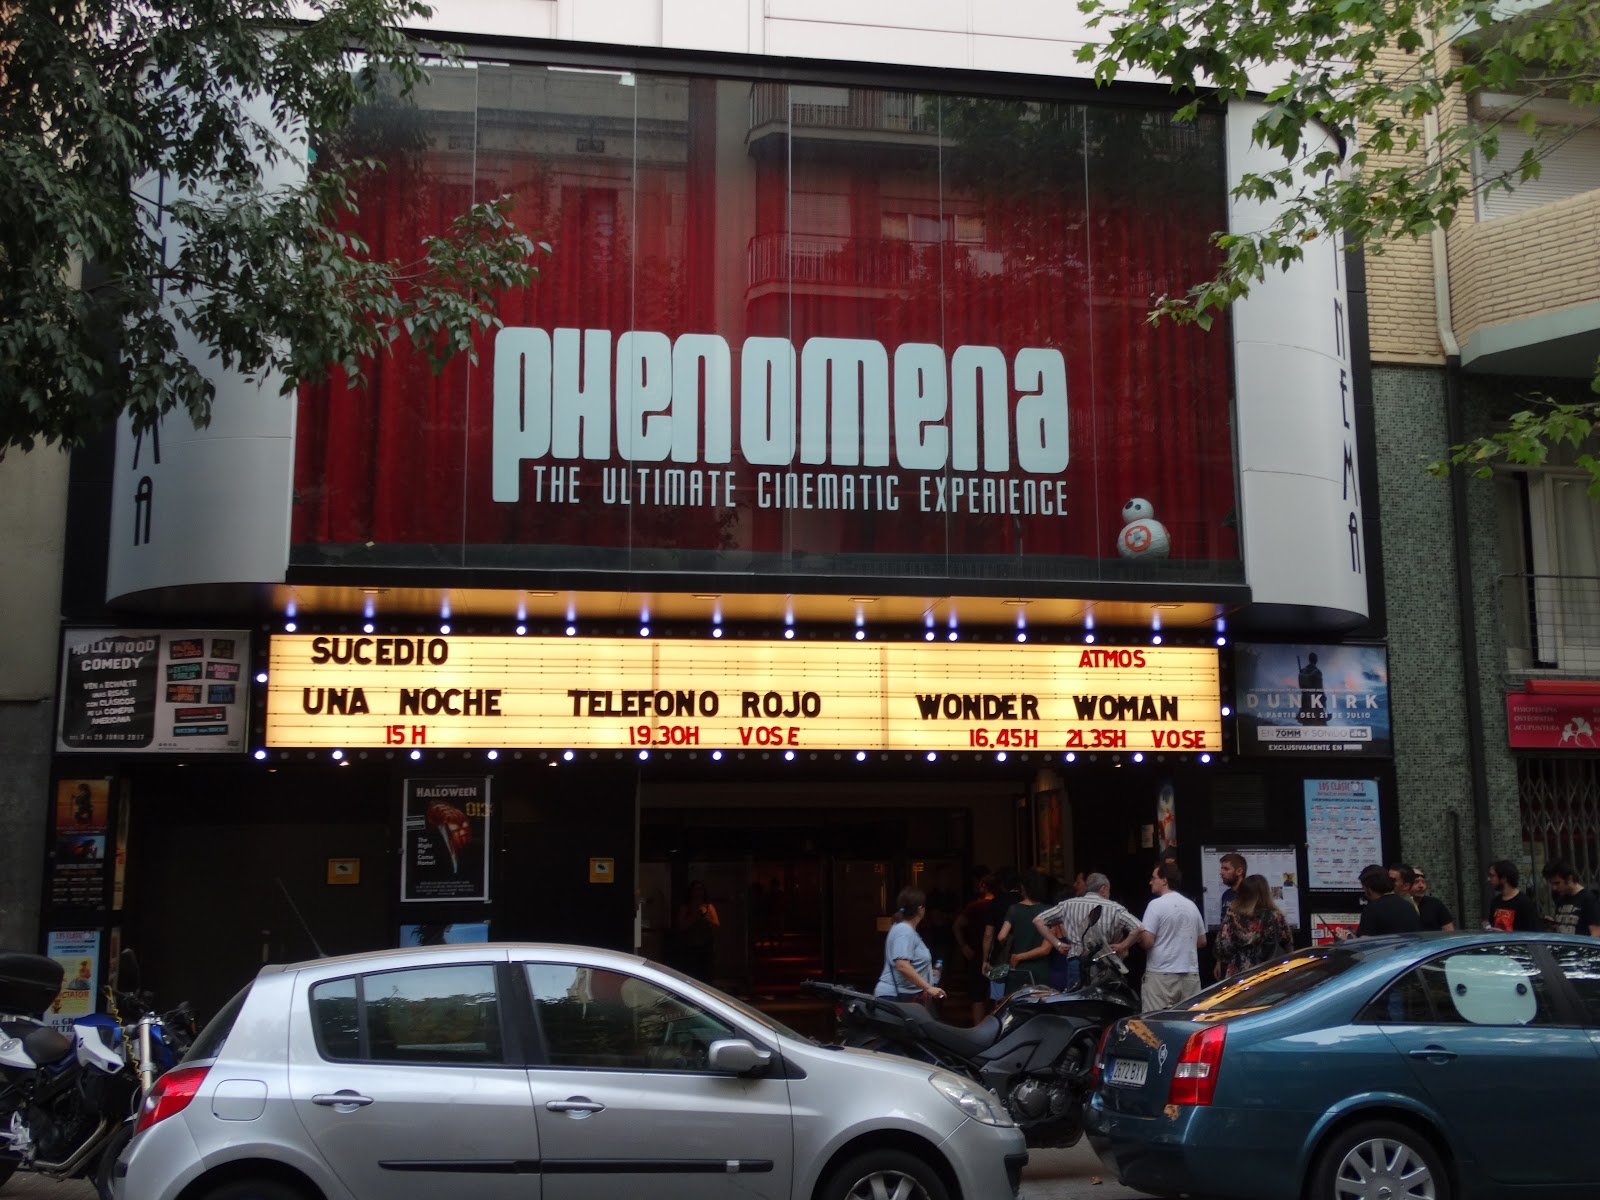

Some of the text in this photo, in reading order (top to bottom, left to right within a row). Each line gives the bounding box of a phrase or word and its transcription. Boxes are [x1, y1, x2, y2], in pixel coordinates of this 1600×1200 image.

[533, 465, 1068, 516] THE ULTIMATE CINEMATIC EXPERIENCE
[72, 639, 156, 655] HOLLYWOOD
[310, 637, 449, 666] SUCEDIO
[81, 657, 144, 672] COMEDY
[1078, 649, 1147, 668] ATMOS
[107, 689, 129, 697] RISAS
[303, 687, 502, 716] UNA NOCHE
[1246, 693, 1378, 709] DUNKIRK
[567, 690, 822, 718] TELEFONO ROJO
[915, 693, 1179, 721] WONDER WOMAN
[629, 725, 800, 746] 19.30H VOSE
[969, 728, 1038, 749] 16.45H
[1151, 730, 1207, 749] VOSE
[1275, 728, 1301, 738] 70MM
[416, 787, 477, 798] HALLOWEEN
